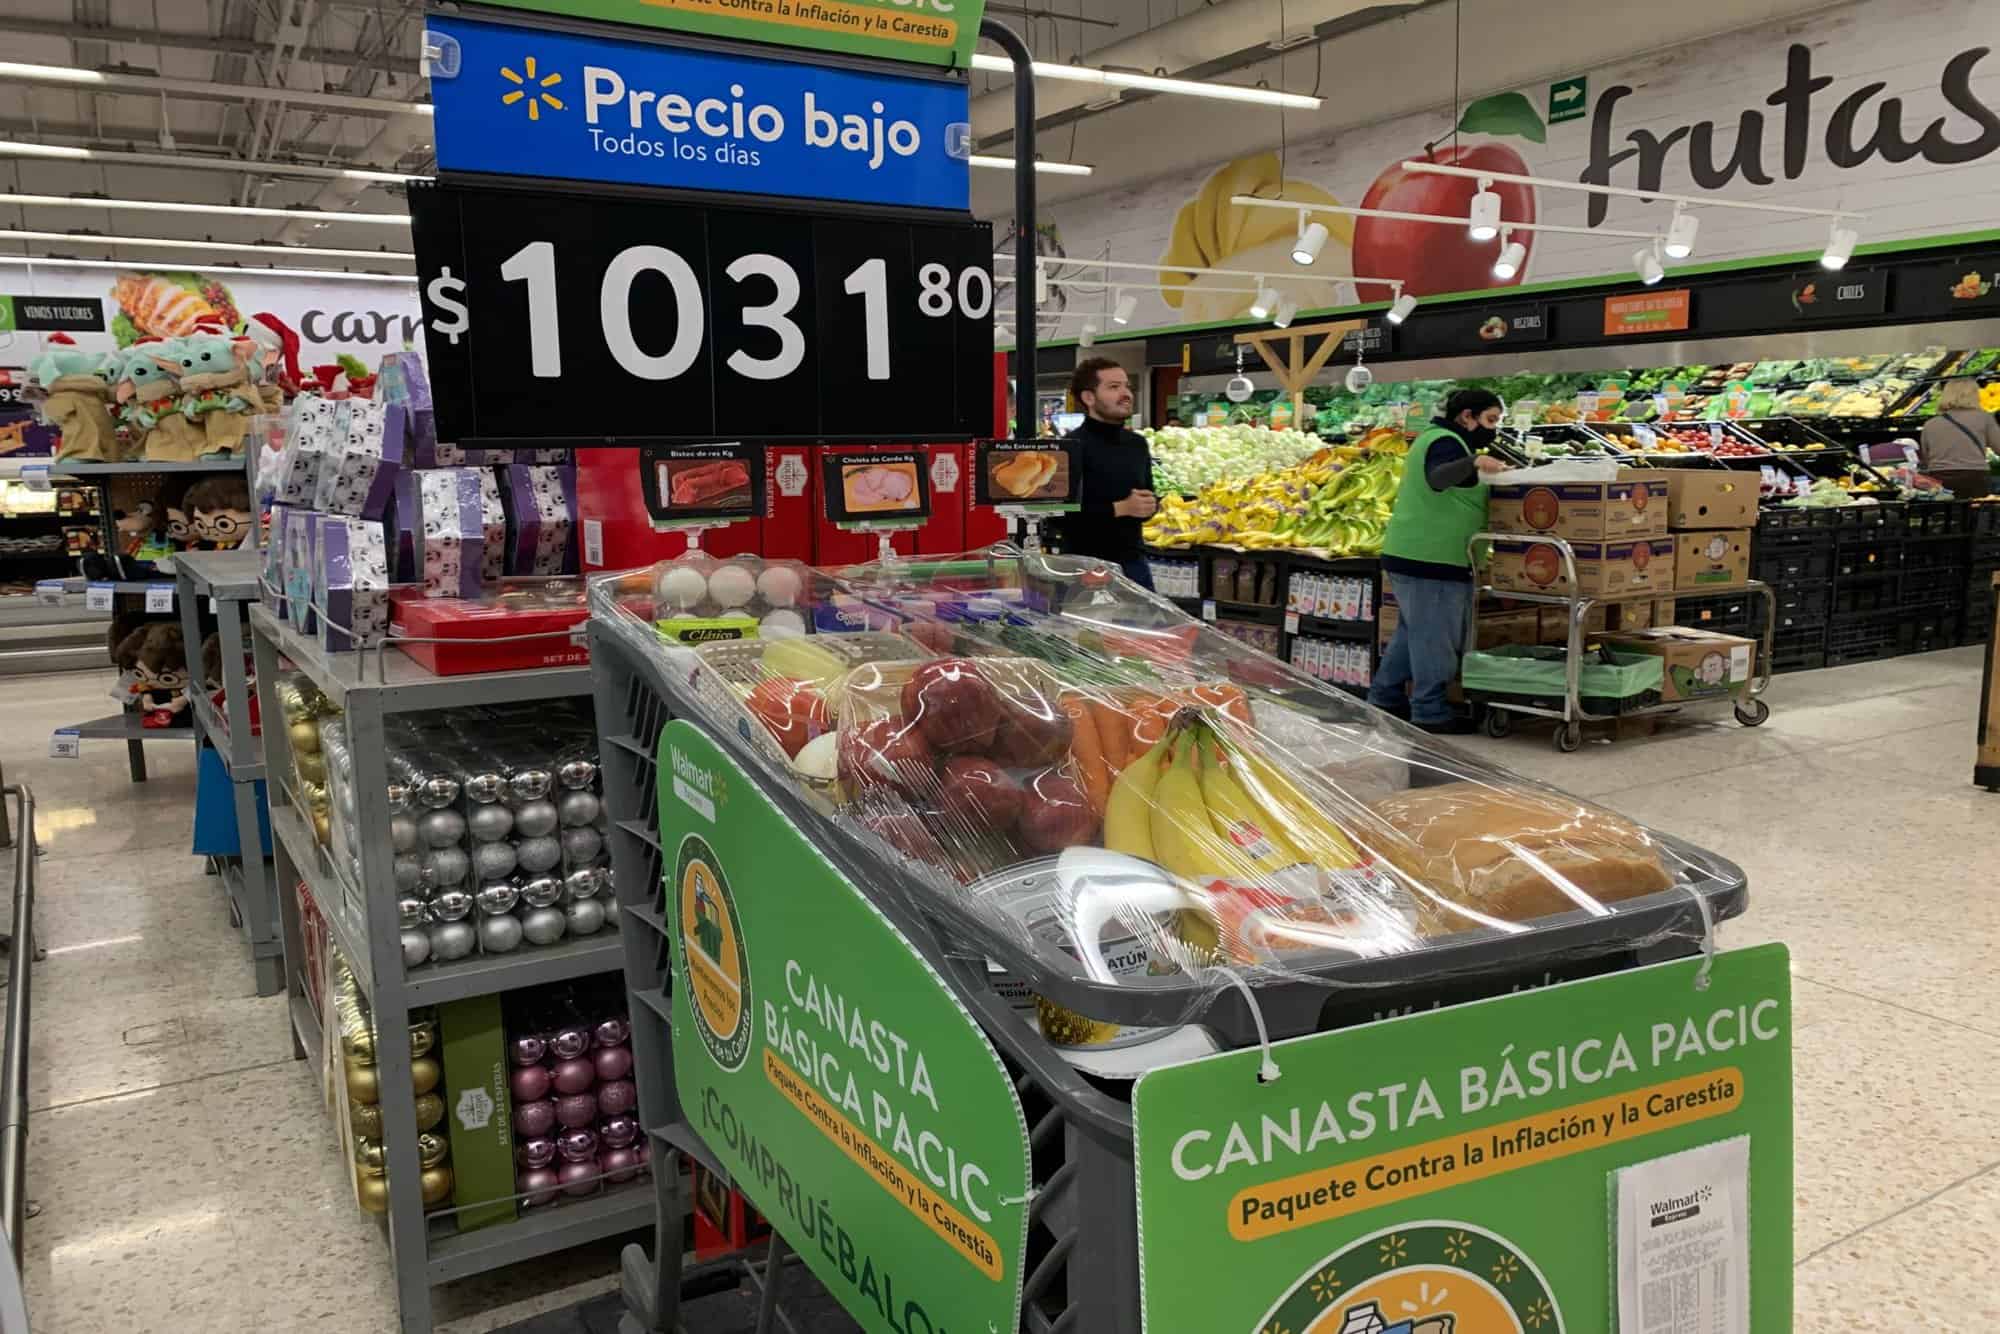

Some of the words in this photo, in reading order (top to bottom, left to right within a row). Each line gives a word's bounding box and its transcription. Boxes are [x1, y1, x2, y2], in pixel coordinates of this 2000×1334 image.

[777, 2, 791, 17] la
[795, 6, 861, 26] Inflación
[863, 16, 873, 32] y
[876, 15, 889, 31] la
[892, 17, 950, 40] Carestía
[583, 66, 785, 143] Precio
[804, 92, 921, 170] bajo
[587, 128, 665, 159] Todos
[673, 137, 707, 163] los
[714, 143, 761, 168] días
[1580, 43, 2000, 229] frutas
[918, 263, 993, 321] 80
[669, 743, 714, 799] Walmart
[1107, 951, 1148, 969] ATÚN
[784, 958, 939, 1113] CANASTA
[1171, 1077, 1445, 1181] CANASTA
[1460, 1044, 1638, 1115] BÁSICA
[1651, 998, 1780, 1068] PACIC
[763, 1000, 866, 1128] BÁSICA
[872, 1090, 993, 1225] PACIC
[767, 1057, 803, 1103] Paquete
[802, 1093, 839, 1136] Contra
[840, 1122, 851, 1144] la
[852, 1132, 905, 1193] Inflación
[906, 1184, 915, 1206] y
[917, 1188, 930, 1214] la
[932, 1203, 994, 1266] Carestía
[1242, 1177, 1357, 1227] Paquete
[1364, 1154, 1456, 1193] Contra
[1462, 1141, 1485, 1167] la
[1491, 1115, 1597, 1160] Inflación
[1601, 1114, 1616, 1139] y
[1619, 1099, 1641, 1127] la
[1646, 1077, 1736, 1120] Carestía
[701, 1086, 948, 1334] ¡COMPRUÉBALO
[1650, 1191, 1699, 1217] Walmart
